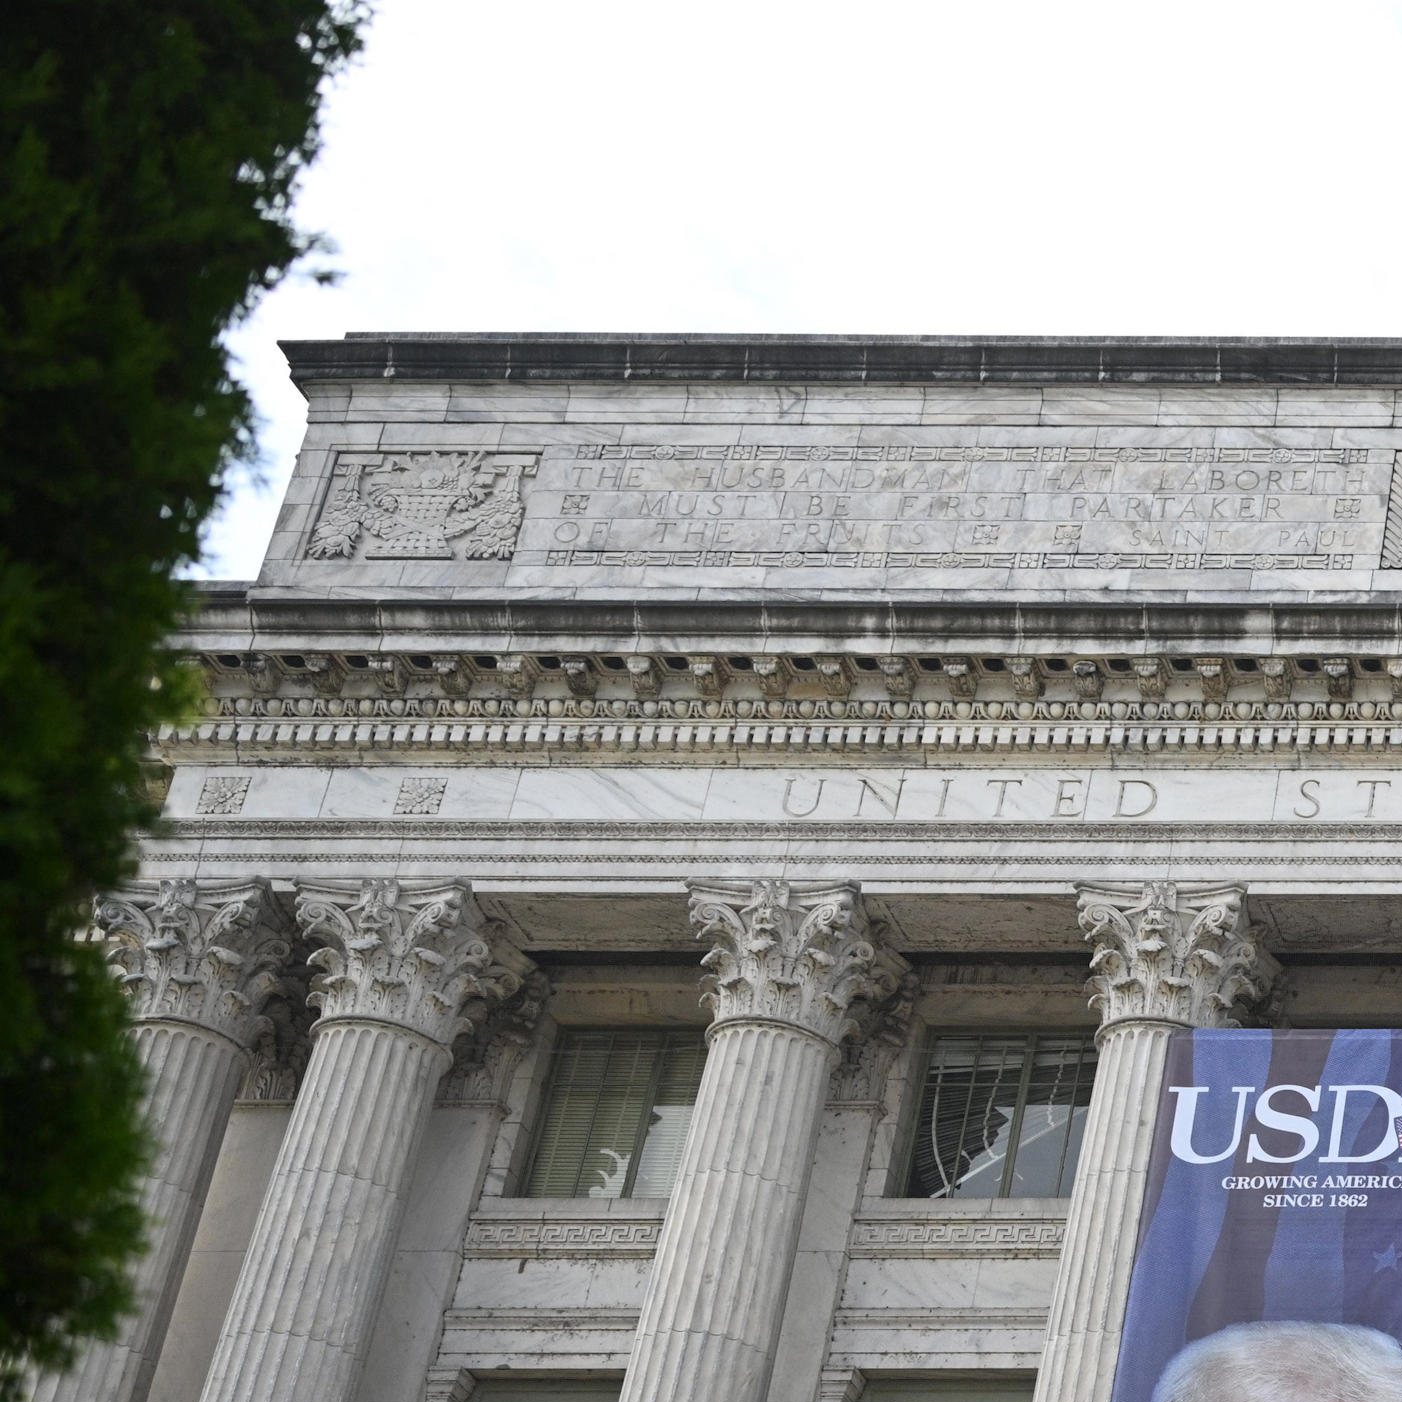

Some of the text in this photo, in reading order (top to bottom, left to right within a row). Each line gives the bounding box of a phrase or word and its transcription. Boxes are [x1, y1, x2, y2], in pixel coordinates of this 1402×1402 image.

[572, 466, 1368, 492] THE HUSBANDMAN THAT LABORETH
[638, 495, 1282, 519] MUST BE FIRST PARTAKER
[553, 521, 1354, 547] OF THE FRUITS SAINT PAUL
[783, 778, 1159, 820] UNITED
[1221, 1175, 1317, 1190] GROWING
[1263, 1194, 1368, 1208] SINCE 1862
